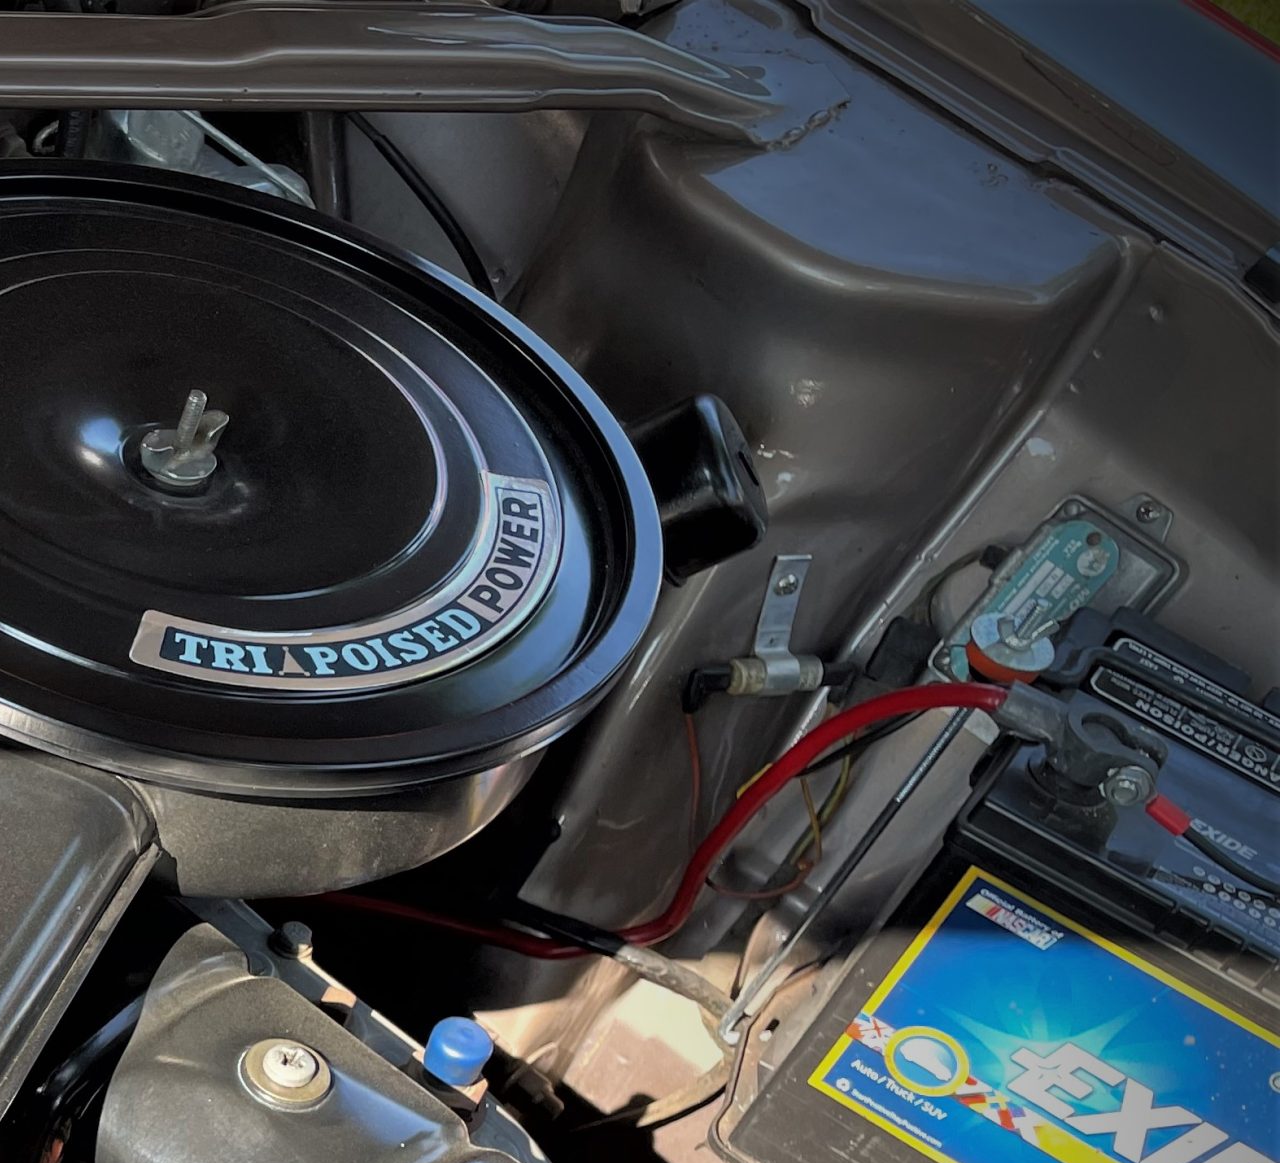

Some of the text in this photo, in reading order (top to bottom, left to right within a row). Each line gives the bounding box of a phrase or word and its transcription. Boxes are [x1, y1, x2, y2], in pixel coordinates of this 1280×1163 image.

[173, 496, 541, 676] TRI POISED POWER
[1189, 817, 1258, 861] EXIDE
